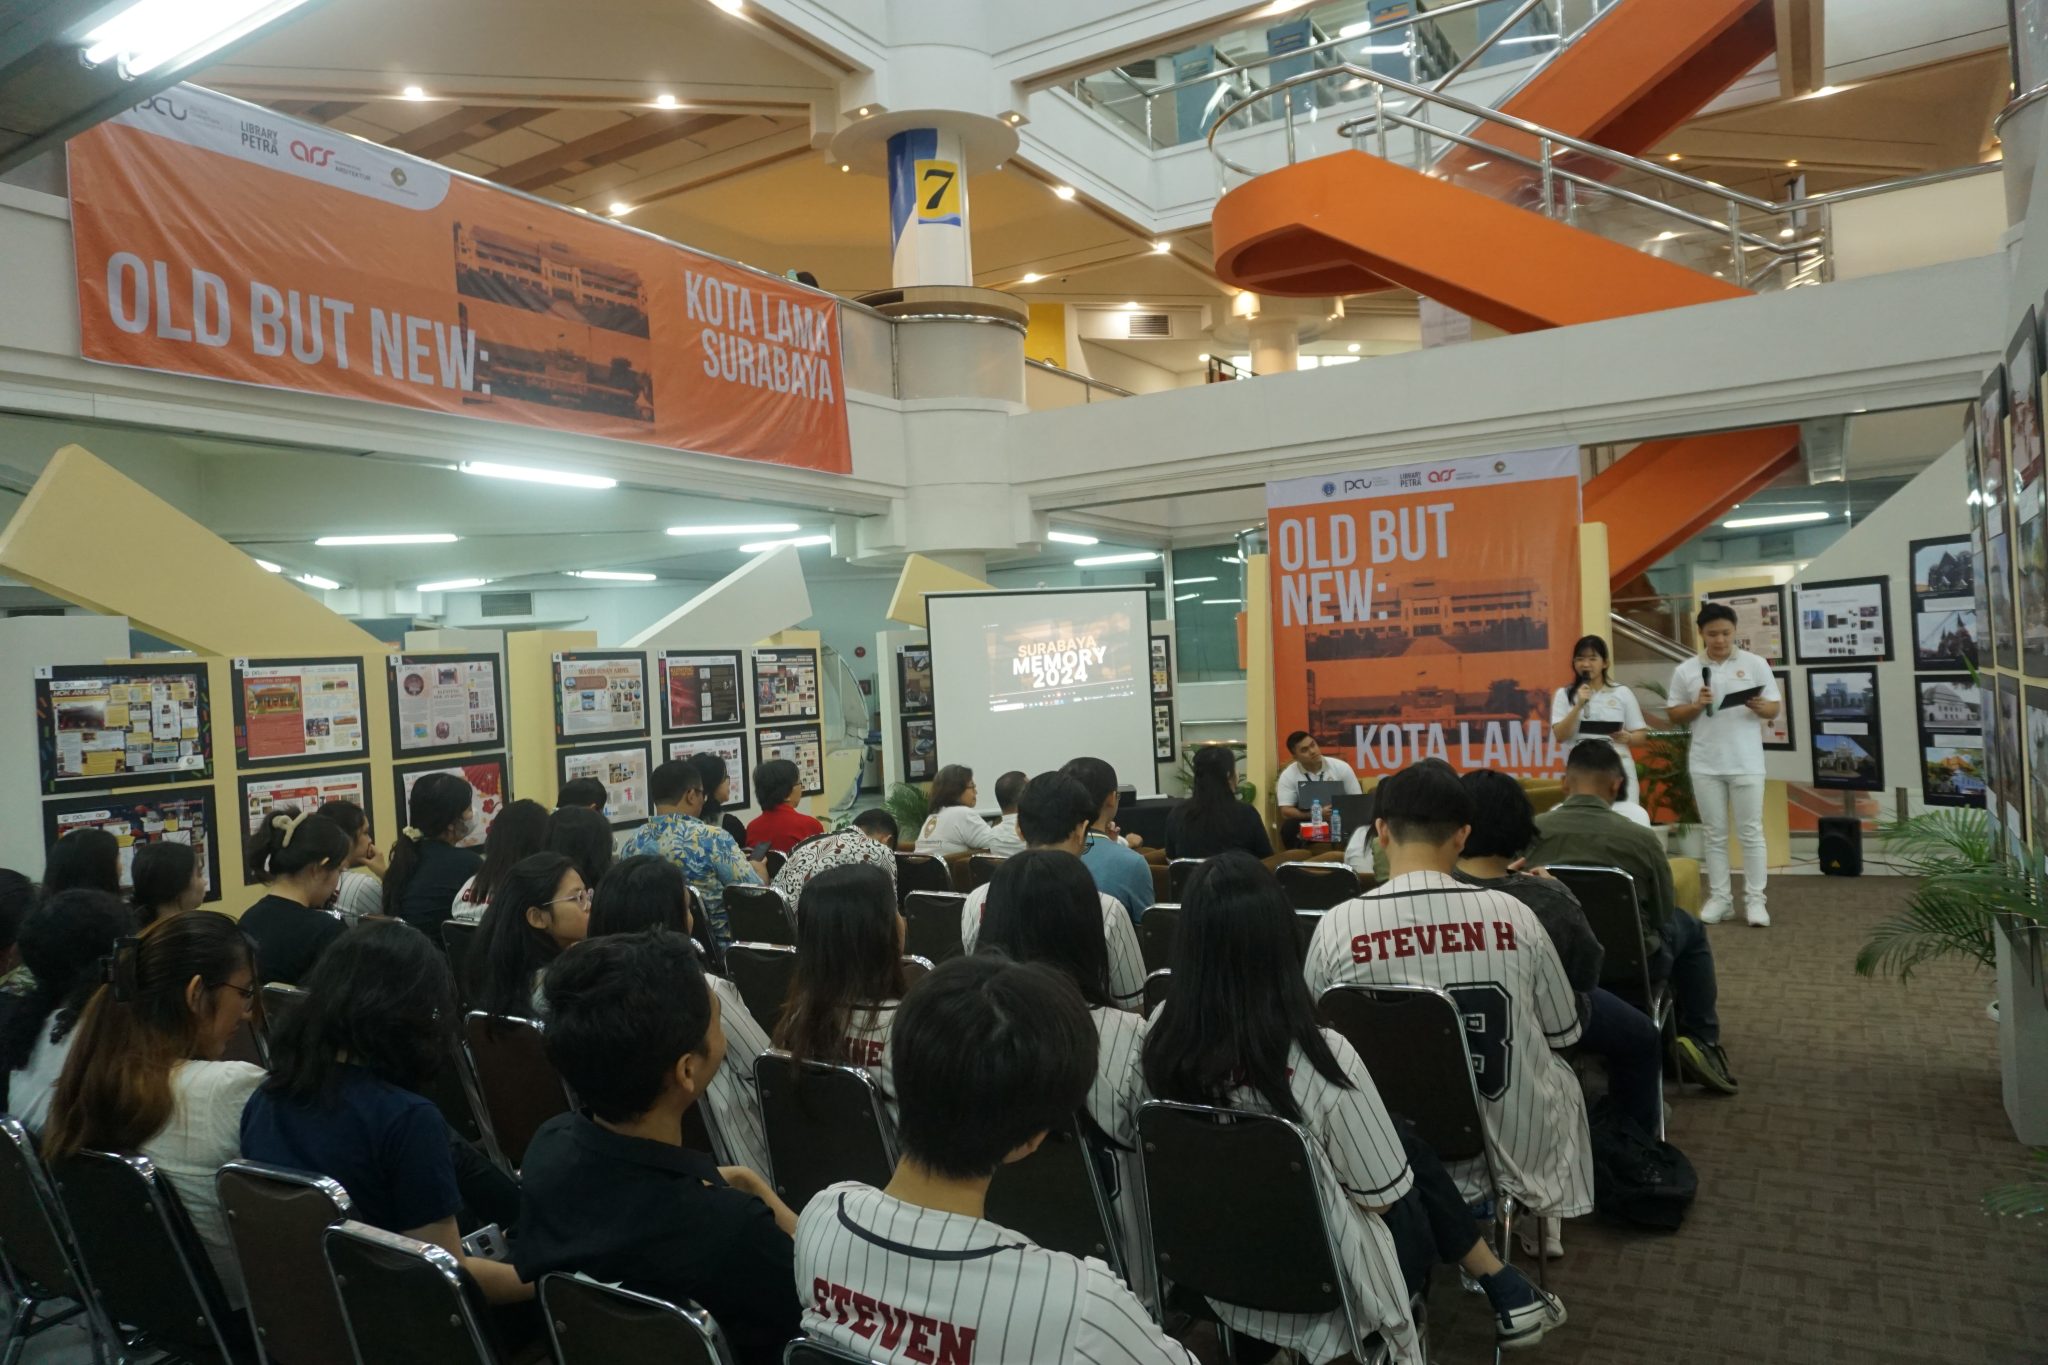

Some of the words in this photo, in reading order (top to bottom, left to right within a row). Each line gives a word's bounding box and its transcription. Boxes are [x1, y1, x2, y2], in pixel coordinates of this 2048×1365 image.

[241, 121, 279, 139] LIBRARY
[241, 132, 280, 156] PETRA
[922, 168, 955, 210] 7
[106, 251, 232, 348] OLD
[250, 280, 354, 370] BUT
[370, 306, 491, 395] NEW:
[684, 269, 757, 336] KOTA
[762, 296, 830, 356] LAMA
[701, 328, 835, 404] SURABAYA
[1400, 471, 1421, 480] LIBRARY
[1400, 479, 1422, 487] PETRA
[1278, 512, 1357, 572] OLD
[1369, 503, 1455, 564] BUT
[1281, 568, 1388, 627] NEW:
[1012, 646, 1107, 675] MEMORY
[1018, 635, 1098, 658] SURABAYA
[1032, 662, 1089, 688] 2024
[1355, 722, 1450, 770] KOTA
[1351, 922, 1486, 964] STEVEN
[1492, 921, 1518, 951] H
[811, 1276, 977, 1365] STEVEN
